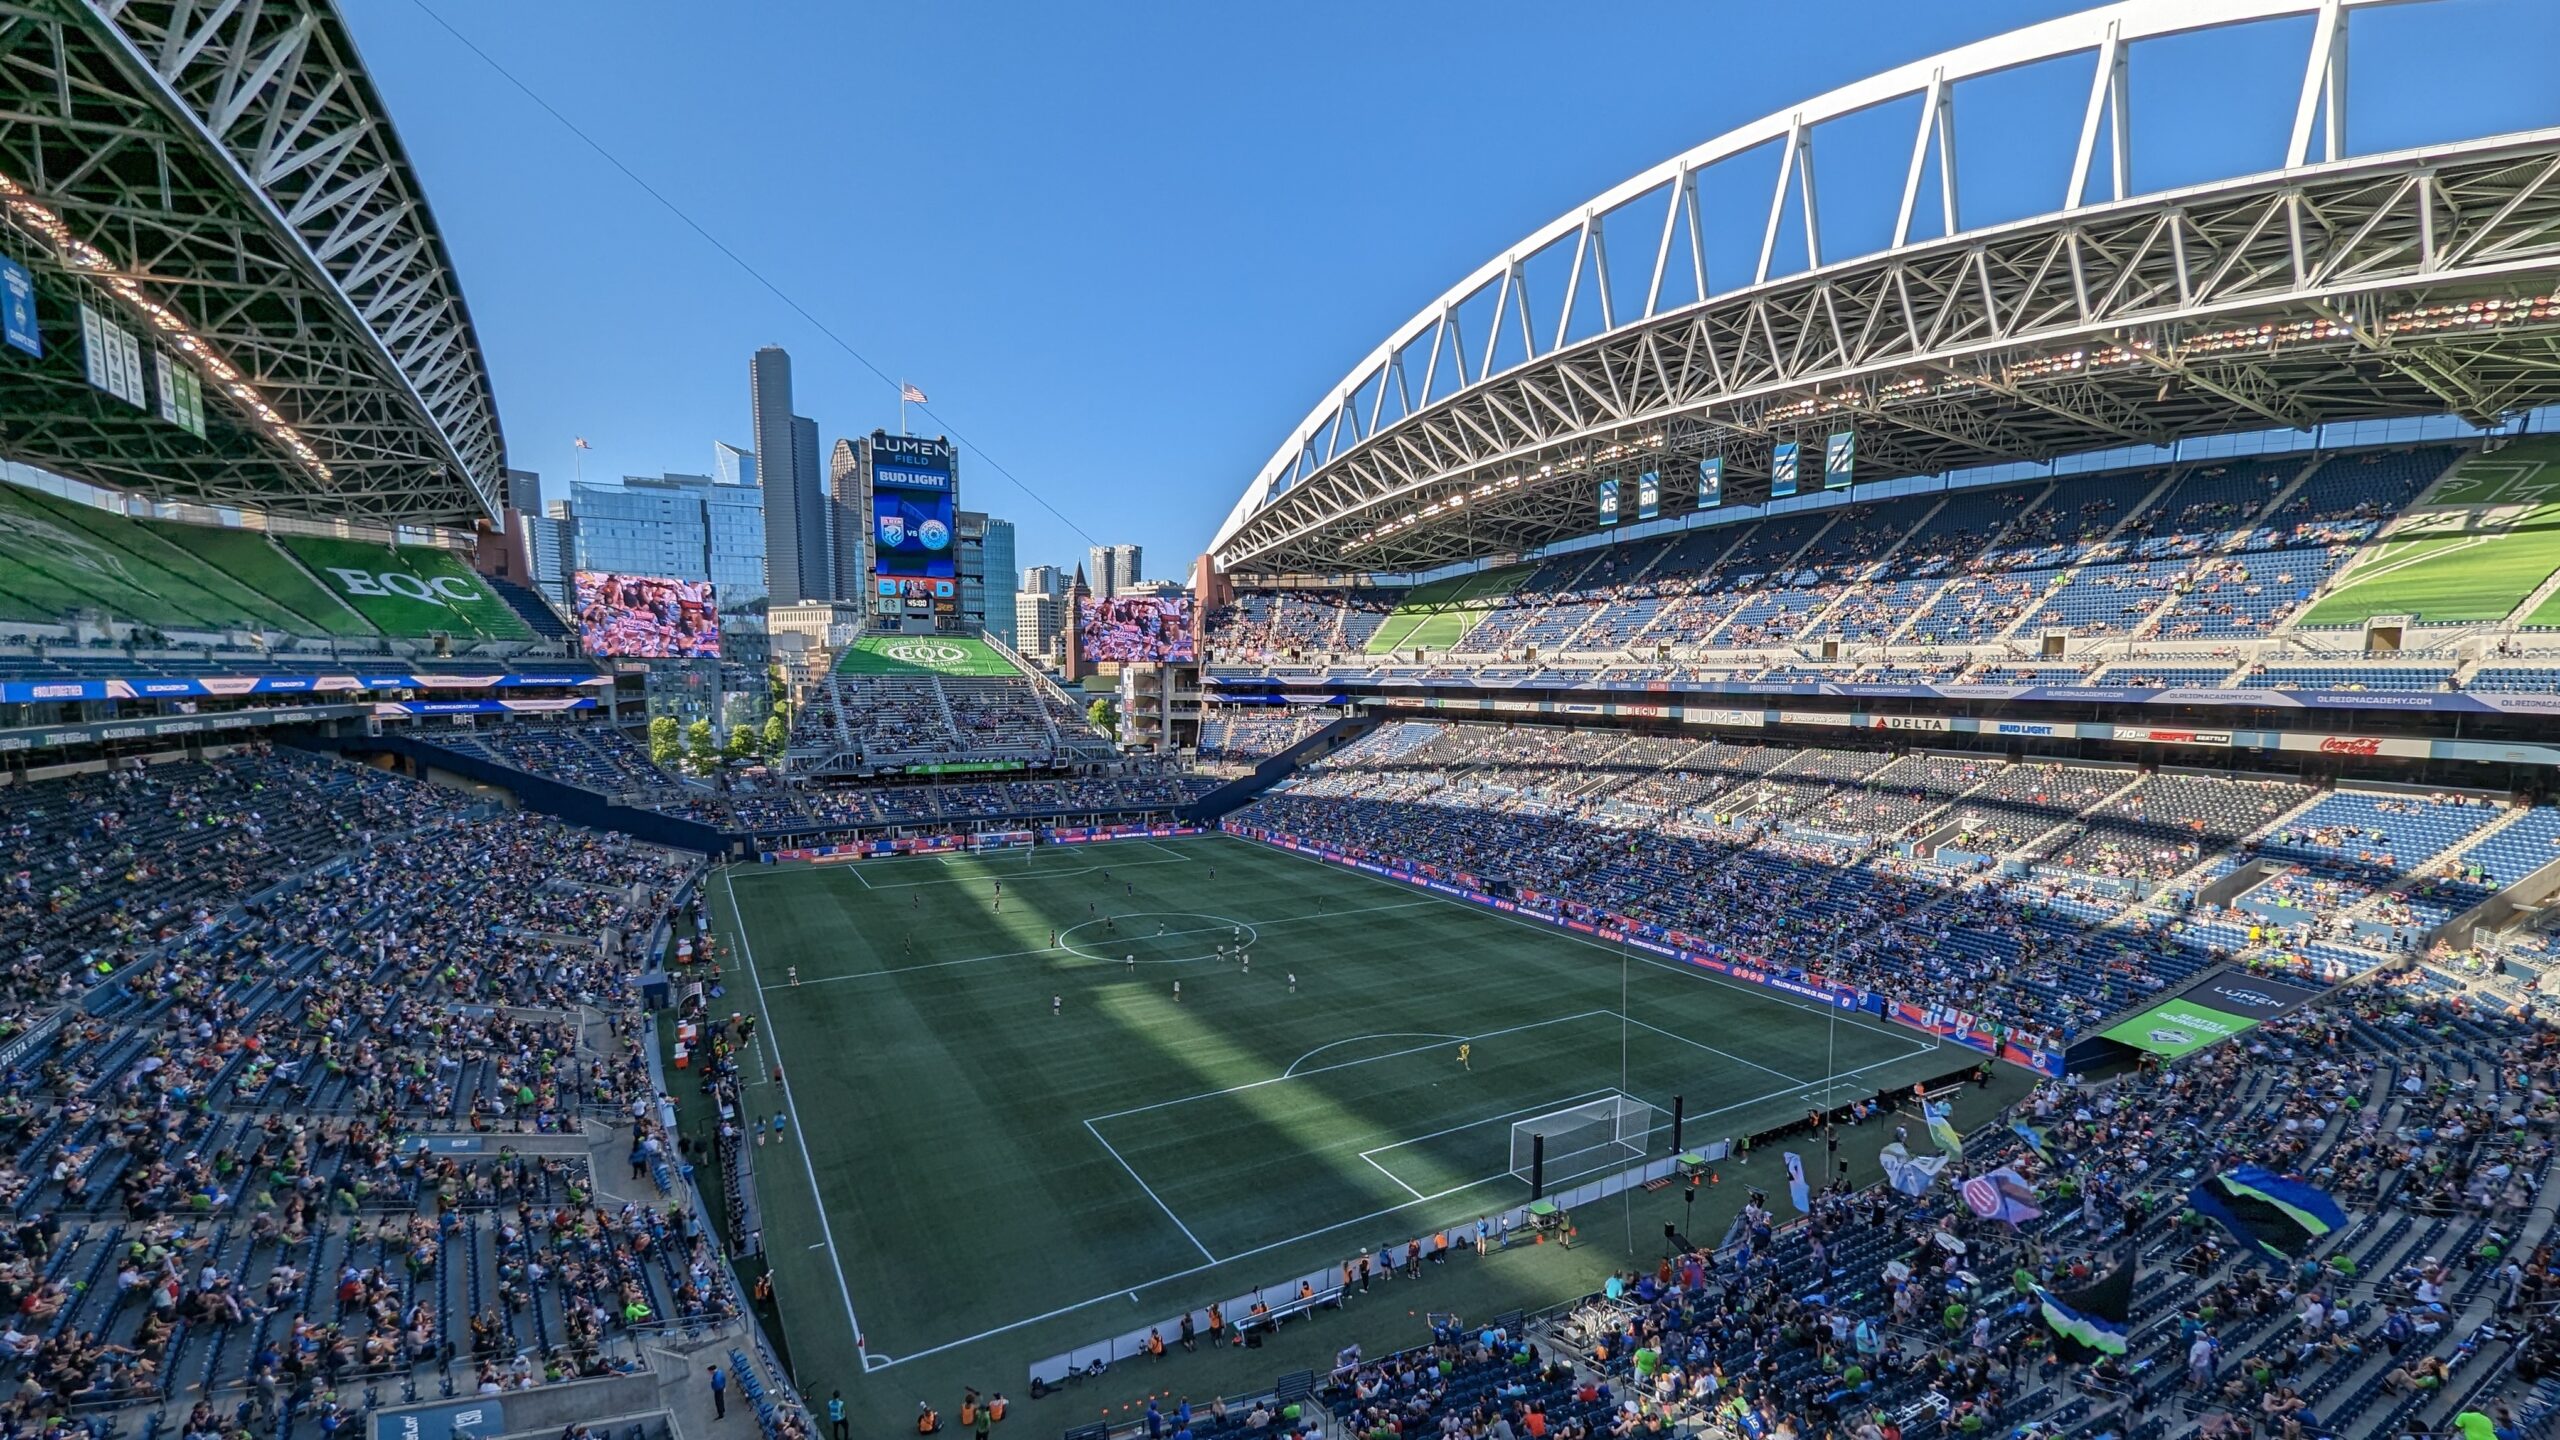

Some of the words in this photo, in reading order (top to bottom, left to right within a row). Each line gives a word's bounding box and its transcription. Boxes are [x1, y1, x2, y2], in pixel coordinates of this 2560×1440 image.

[872, 437, 949, 457] LUMEN
[895, 454, 929, 466] FIELD
[879, 471, 907, 483] BUD
[909, 473, 945, 486] LIGHT
[1601, 497, 1617, 513] 45
[1641, 490, 1656, 505] 80
[326, 567, 481, 606] EQC
[878, 579, 954, 597] BD
[2317, 695, 2432, 705] OLREIGNACADEMY.COM
[1626, 706, 1657, 716] BECU
[1688, 710, 1757, 725] LUMEN
[1892, 718, 1942, 730] DELTA
[1999, 724, 2020, 733] BUD
[2022, 725, 2053, 735] LIGHT
[2113, 729, 2136, 739] 710
[1801, 828, 1822, 836] DELTA
[2038, 866, 2068, 877] DELTA
[2100, 878, 2120, 886] CLUB
[1772, 979, 1791, 990] FOLLOW
[1791, 985, 1801, 993] AND
[2214, 986, 2285, 1008] LUMEN
[2179, 1013, 2229, 1030] SEATTLE
[1, 1041, 27, 1066] DELTA
[1749, 1418, 1760, 1430] 15
